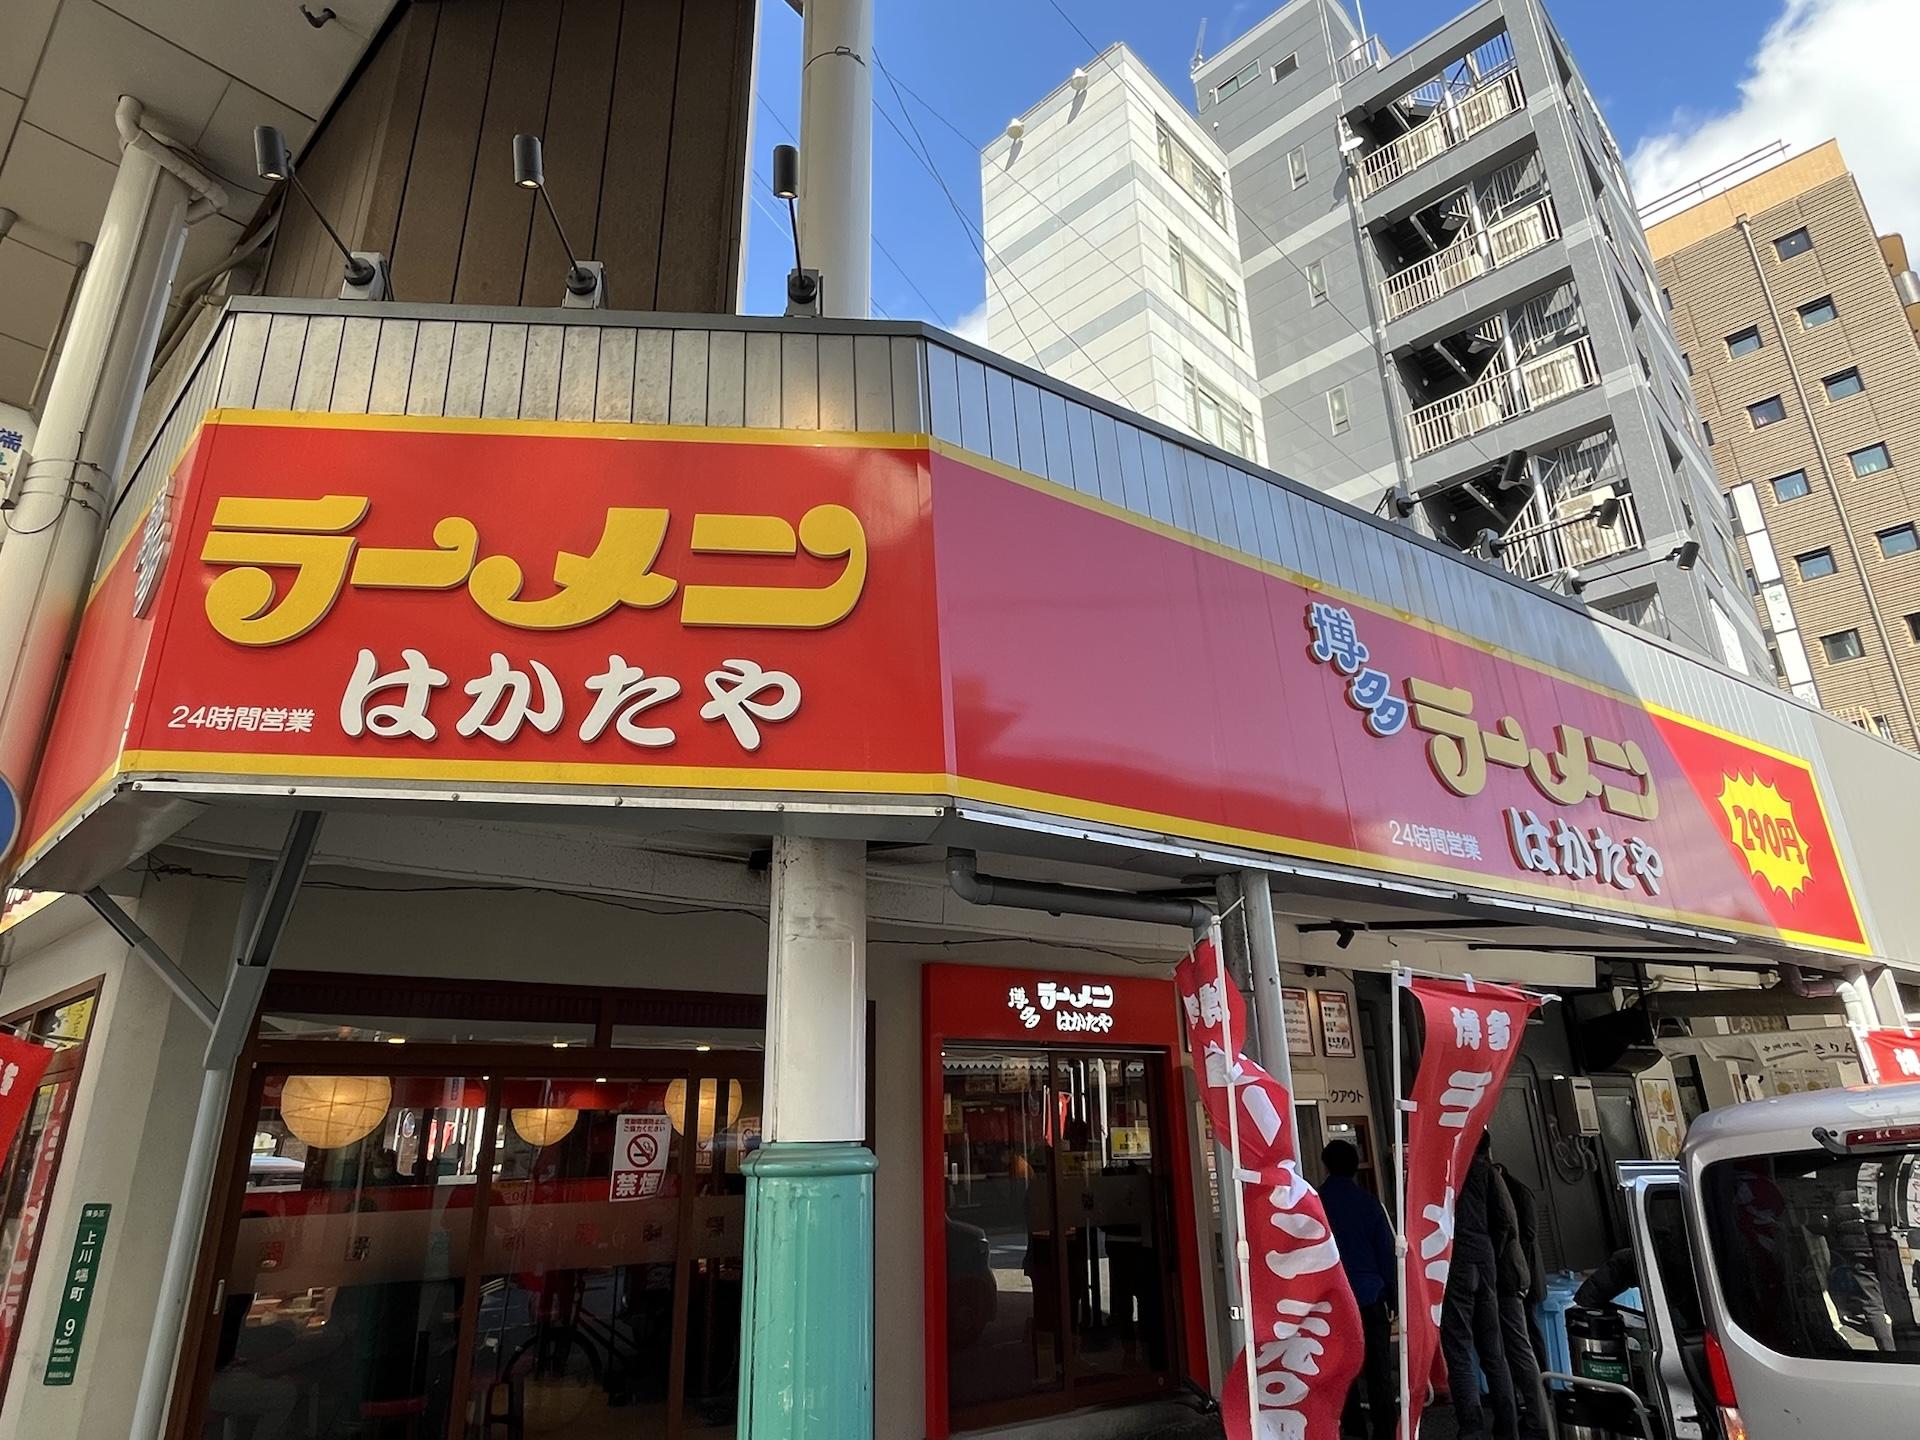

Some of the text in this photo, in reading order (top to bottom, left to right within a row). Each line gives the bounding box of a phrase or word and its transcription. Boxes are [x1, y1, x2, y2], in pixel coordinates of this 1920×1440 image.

[201, 495, 867, 646] ラーメン
[1304, 602, 1408, 738] 博多
[167, 705, 315, 734] 24時間営業
[339, 648, 802, 751] はかたや
[1403, 677, 1659, 821] ラーメン
[1389, 820, 1482, 861] 24時間営業
[1503, 807, 1664, 896] はかたや
[1732, 805, 1805, 864] 290円
[1007, 986, 1041, 1029] 博多
[1037, 982, 1114, 1010] ラーメン
[1056, 1011, 1114, 1033] はかたや
[1450, 1007, 1511, 1050] 博多
[1328, 1089, 1364, 1103] クアウト
[615, 1172, 661, 1197] 禁煙
[69, 1230, 97, 1302] 上川端町
[63, 1318, 76, 1337] 9
